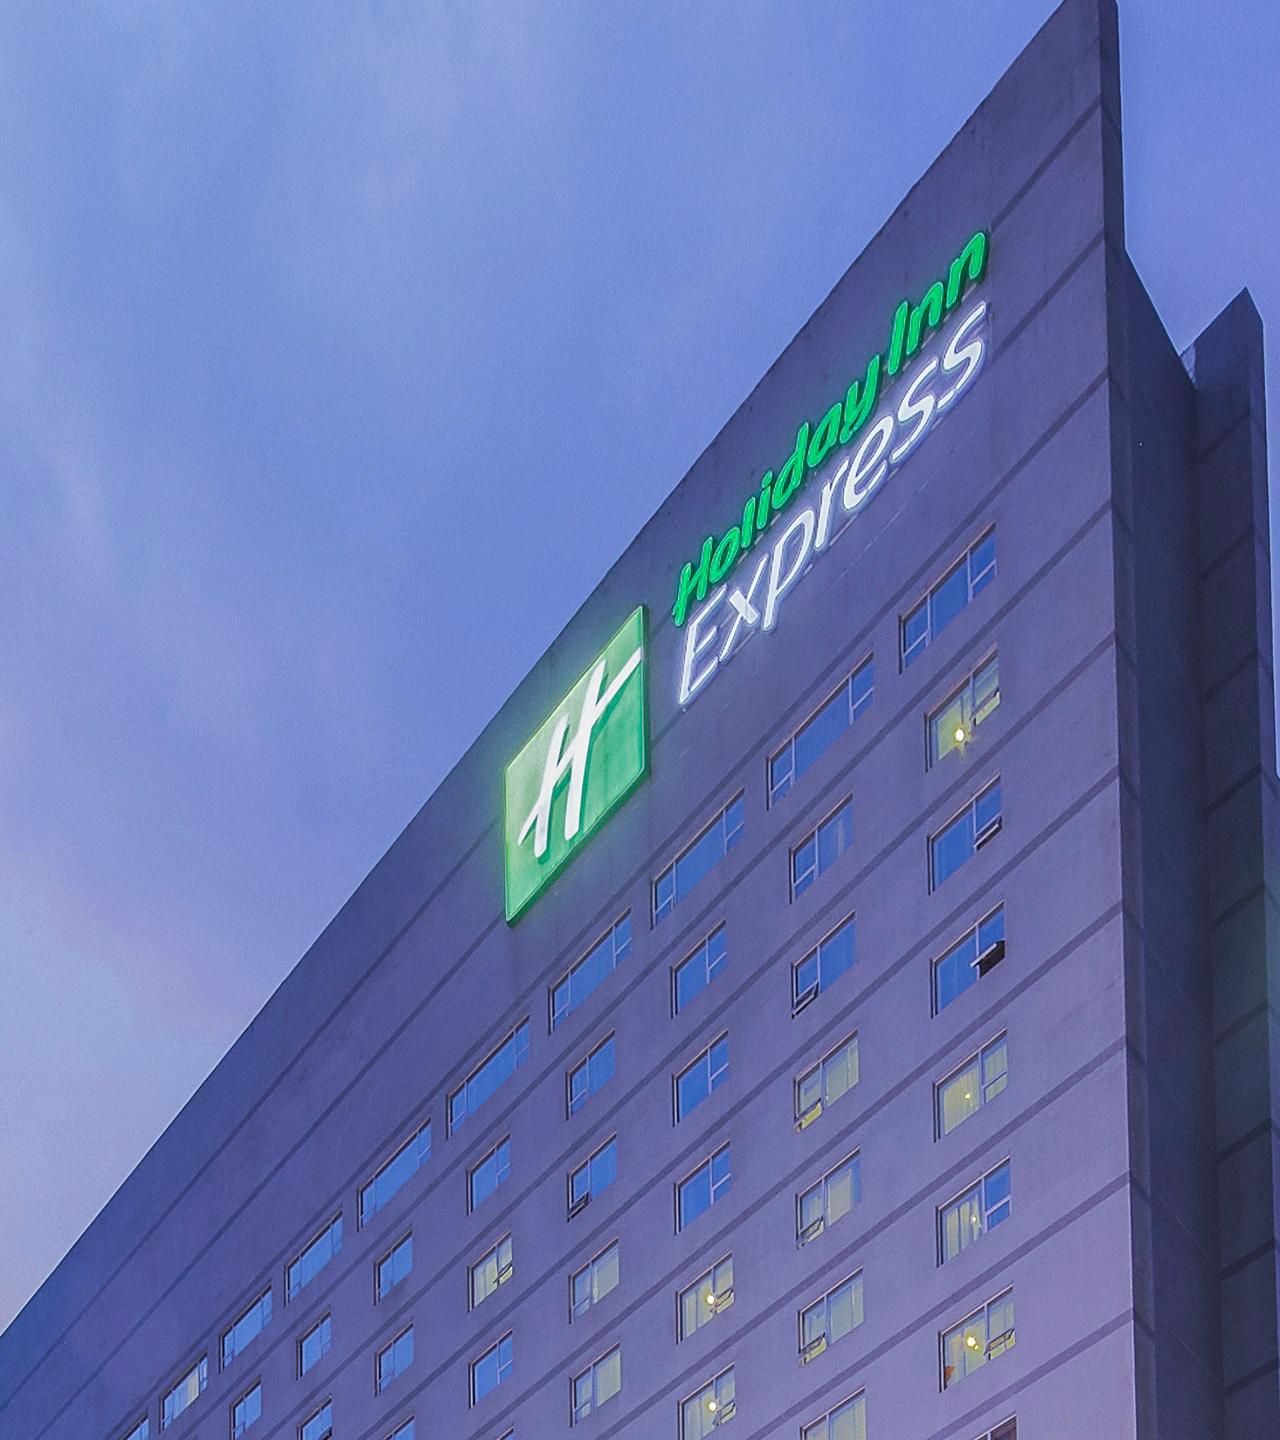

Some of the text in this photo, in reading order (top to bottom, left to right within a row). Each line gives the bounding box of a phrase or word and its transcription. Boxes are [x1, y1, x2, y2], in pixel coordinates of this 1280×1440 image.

[672, 230, 987, 627] Holiday Inn
[677, 301, 988, 704] Express
